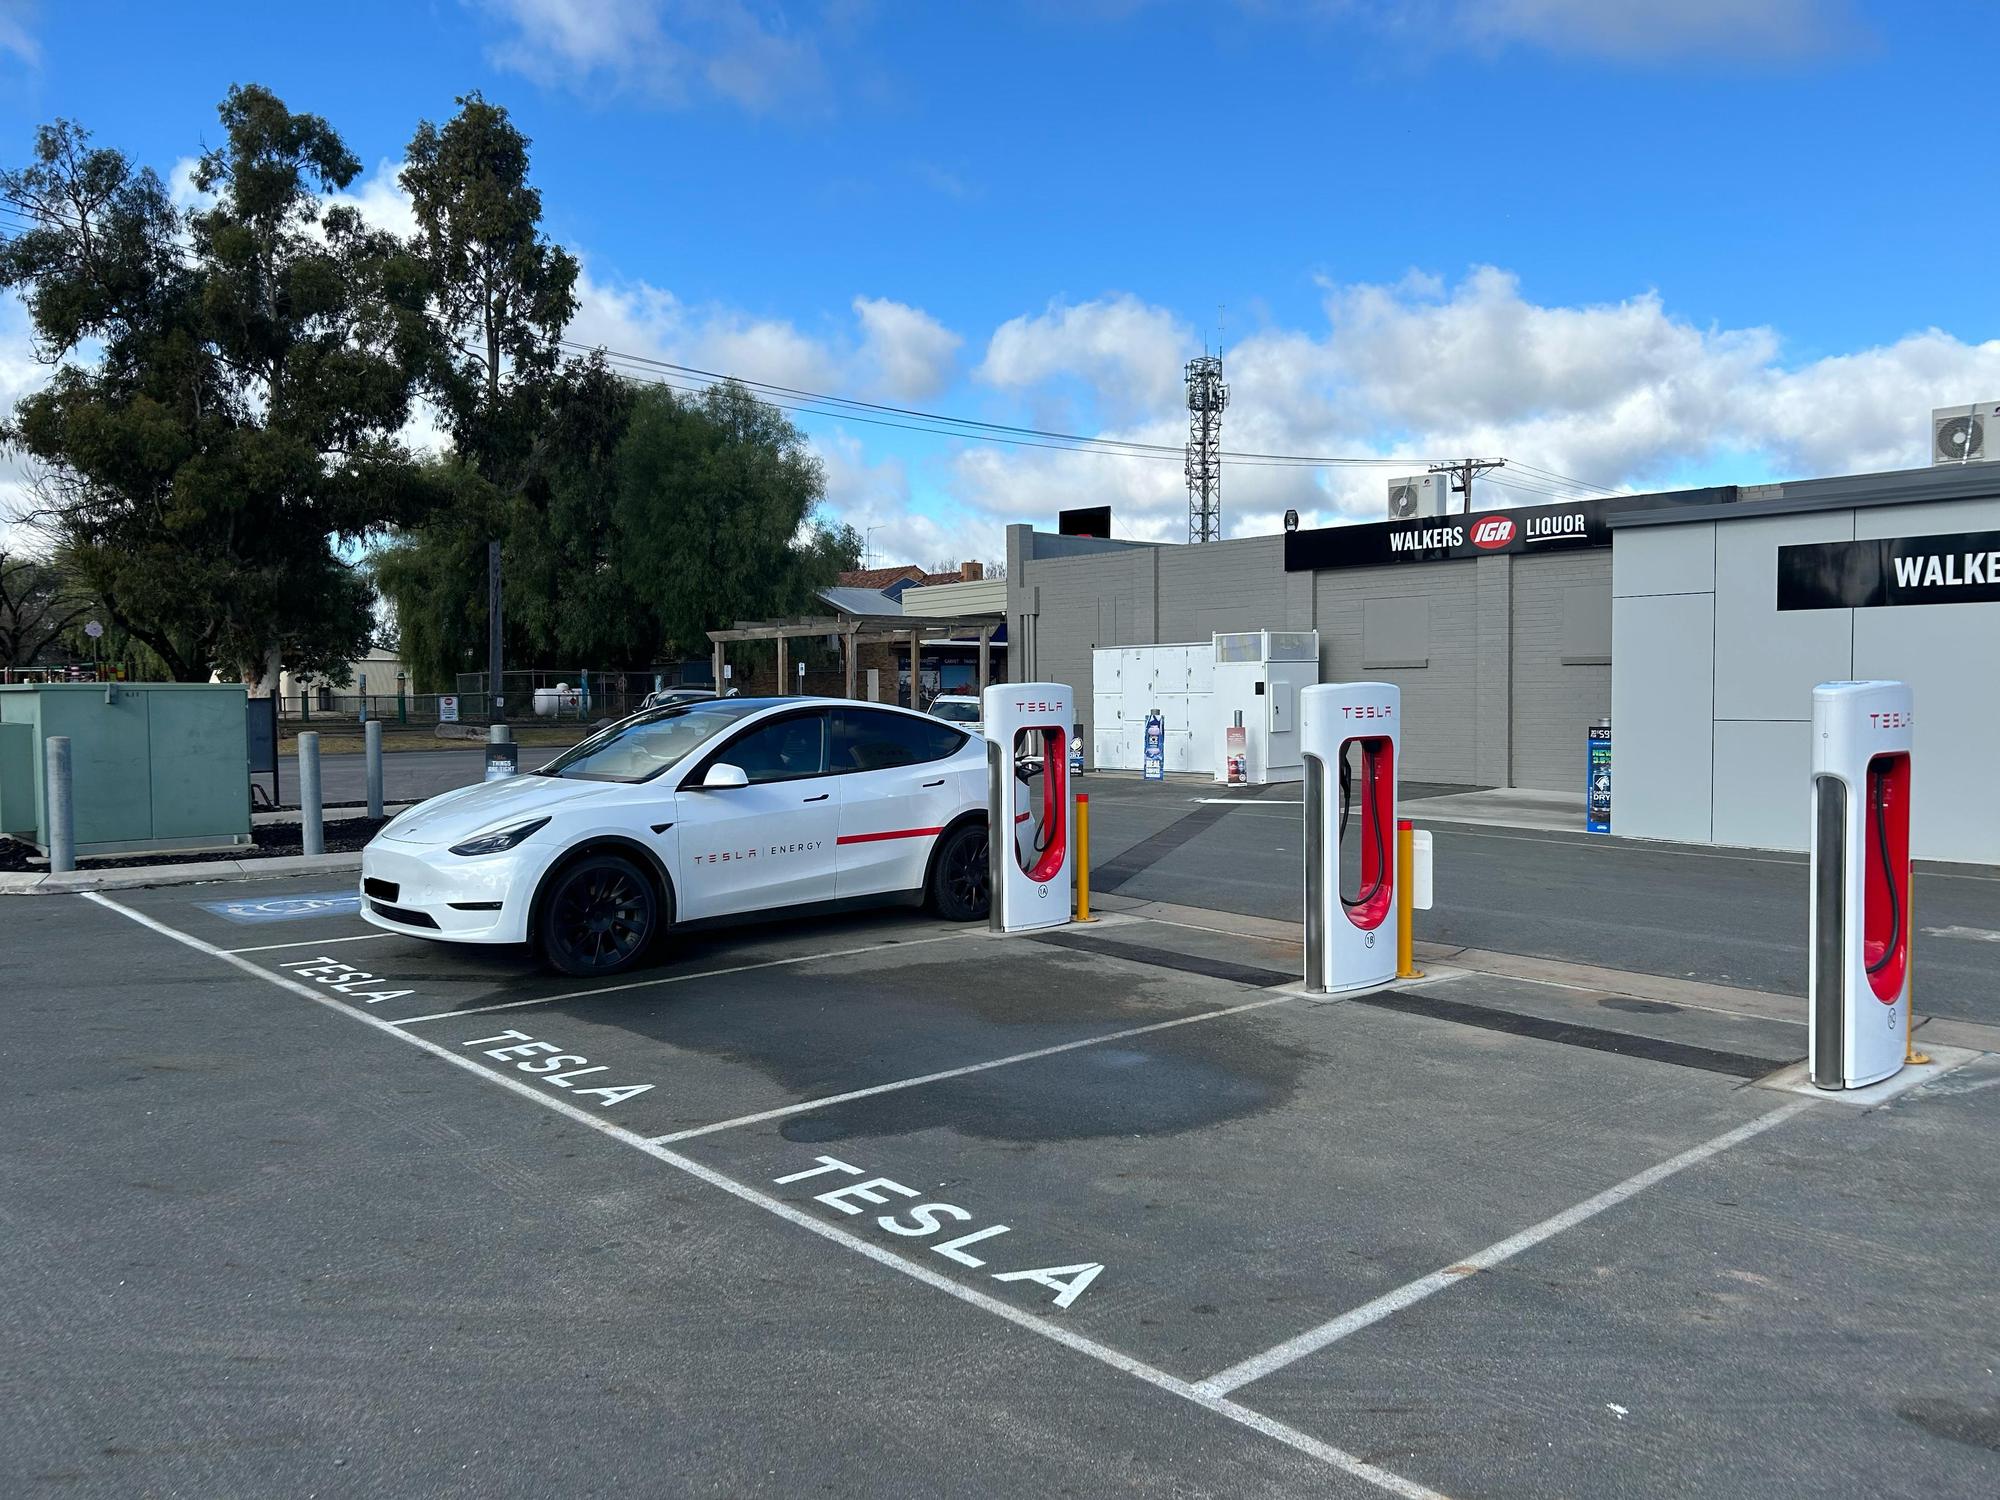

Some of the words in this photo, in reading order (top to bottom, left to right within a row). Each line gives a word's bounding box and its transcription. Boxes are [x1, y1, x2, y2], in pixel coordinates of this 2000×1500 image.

[1390, 526, 1463, 551] WALKERS
[1475, 521, 1512, 543] IGA
[1527, 514, 1585, 536] LIQUOR
[1894, 552, 2000, 587] WALKE
[1016, 702, 1062, 712] TESLA
[1342, 706, 1391, 719] TESLA
[694, 849, 757, 865] TESLA
[771, 841, 822, 855] ENERGY
[278, 956, 415, 1005] TESLA
[462, 1029, 655, 1108] TESLA
[774, 1155, 1105, 1310] TESLA
